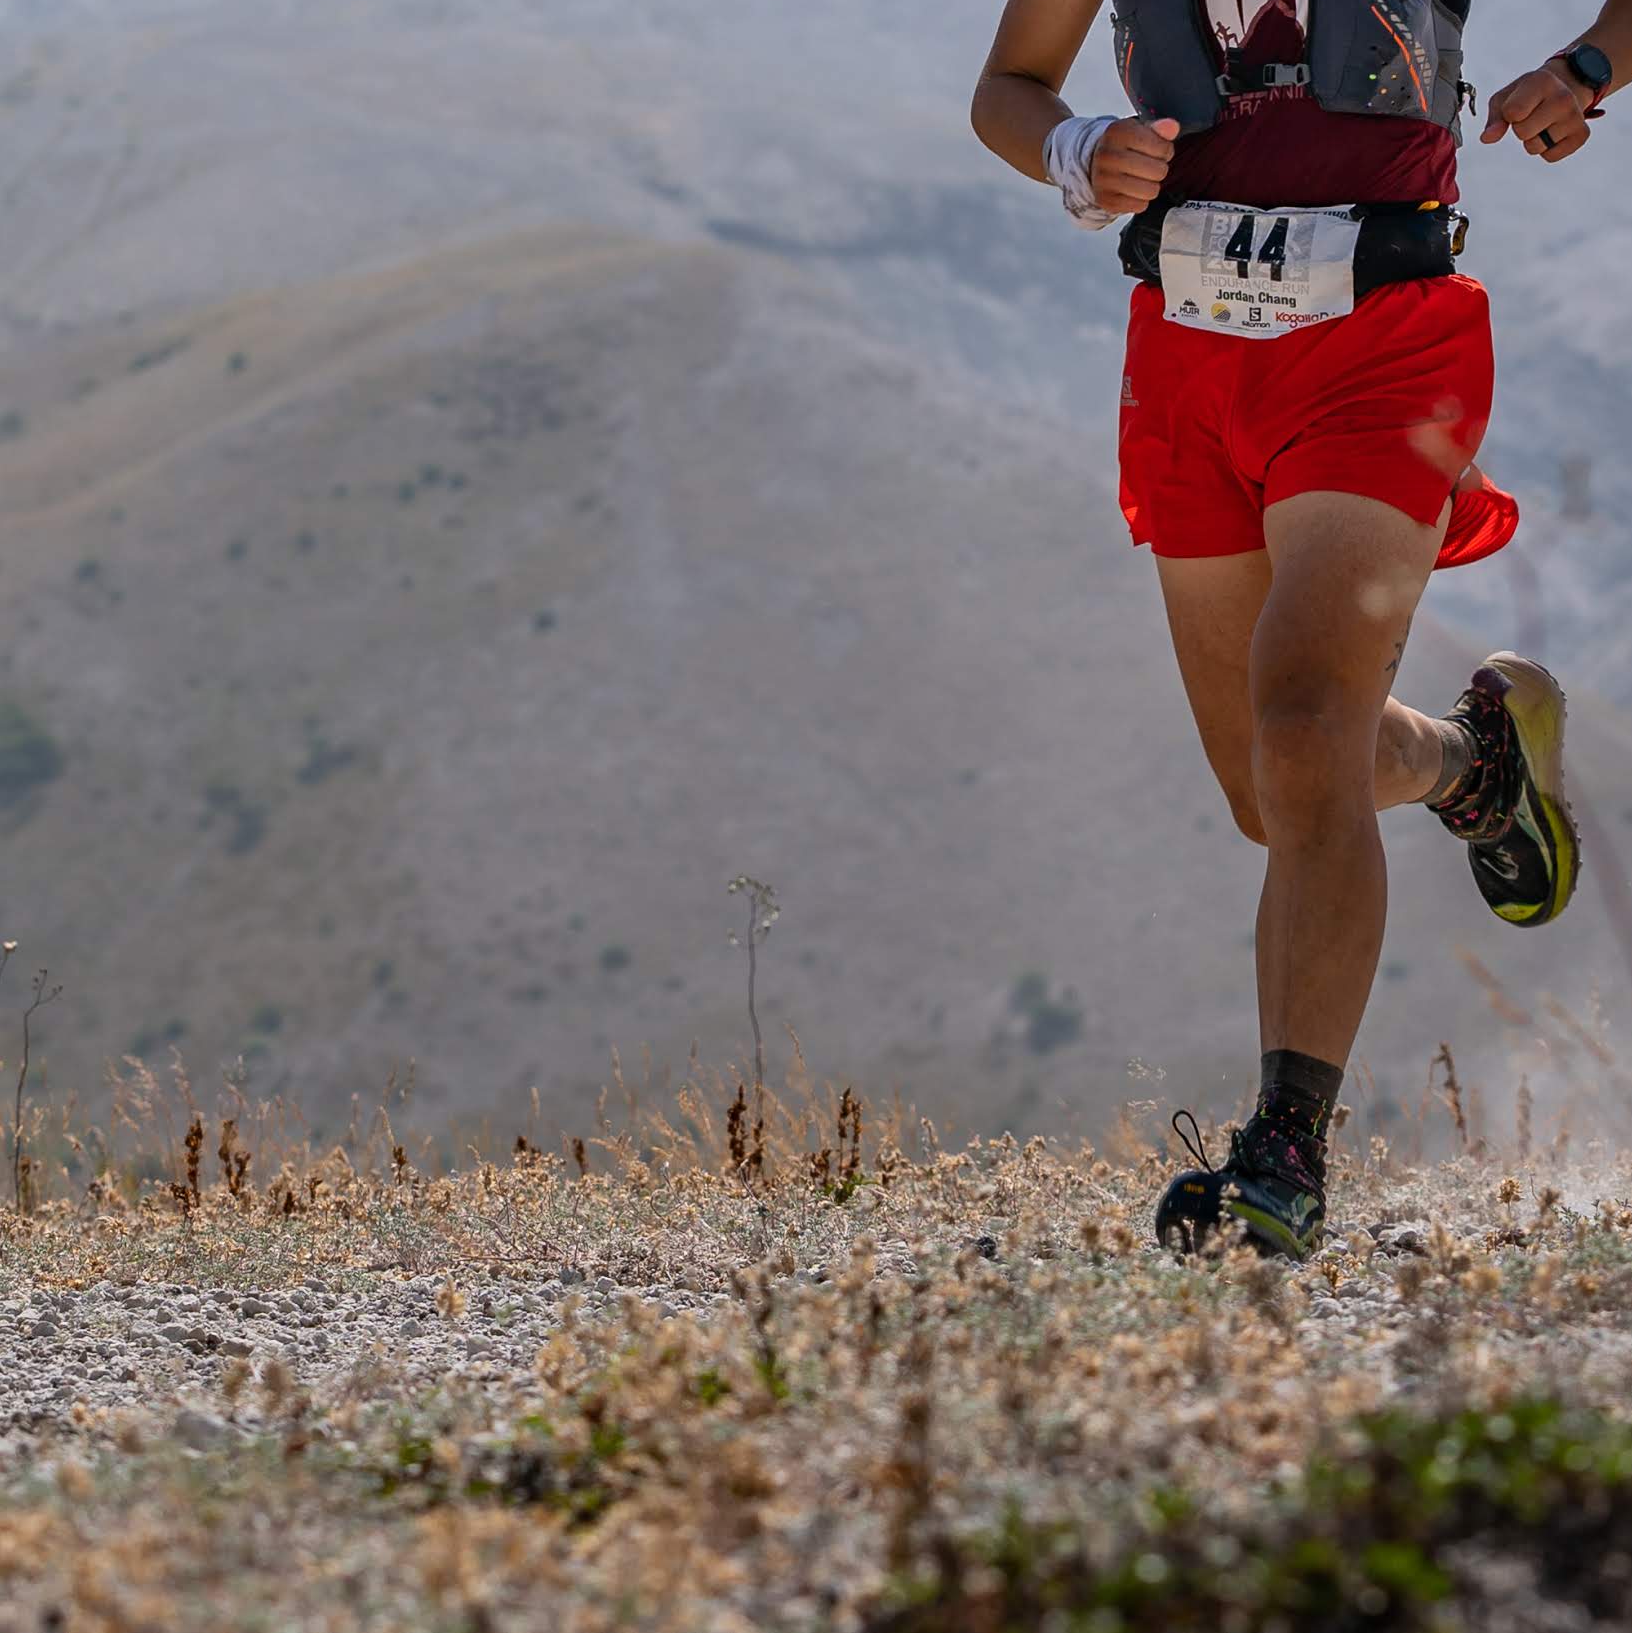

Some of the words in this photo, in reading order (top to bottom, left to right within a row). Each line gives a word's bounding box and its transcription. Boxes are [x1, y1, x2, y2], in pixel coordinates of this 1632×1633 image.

[1224, 215, 1288, 281] 44
[1201, 275, 1277, 292] ENDURANCE
[1281, 282, 1310, 295] RUN
[1216, 289, 1255, 303] Jordan
[1258, 291, 1297, 308] Chang
